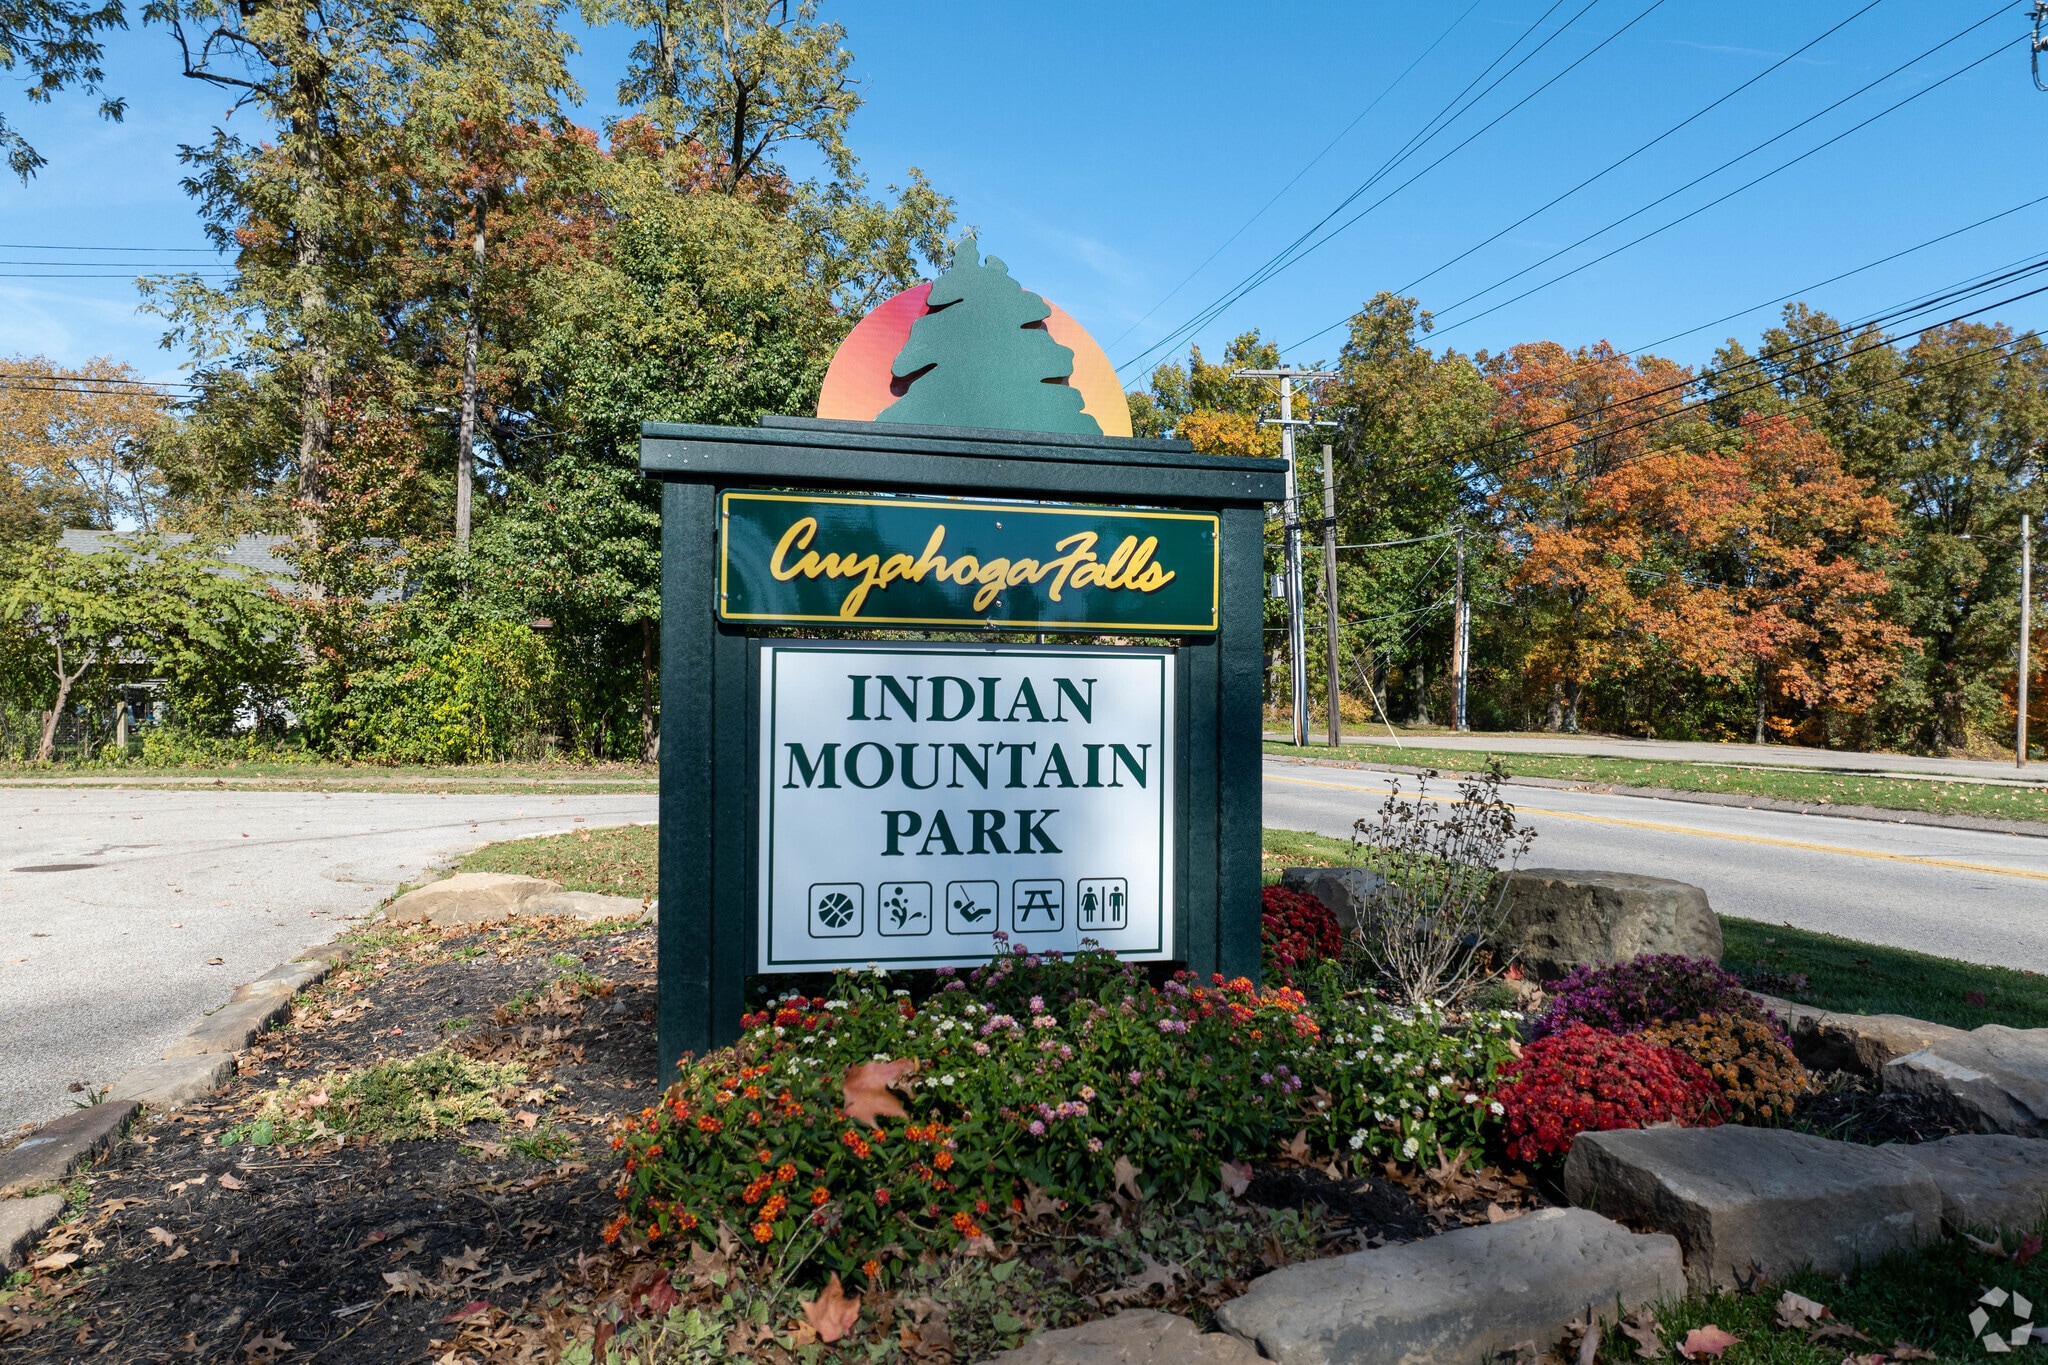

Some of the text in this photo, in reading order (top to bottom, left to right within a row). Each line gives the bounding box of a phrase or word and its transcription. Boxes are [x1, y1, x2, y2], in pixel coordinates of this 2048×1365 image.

[769, 516, 1177, 619] Cuyahoga Falls
[846, 674, 1098, 724] INDIAN
[782, 741, 1152, 790] MOUNTAIN
[880, 808, 1064, 856] PARK
